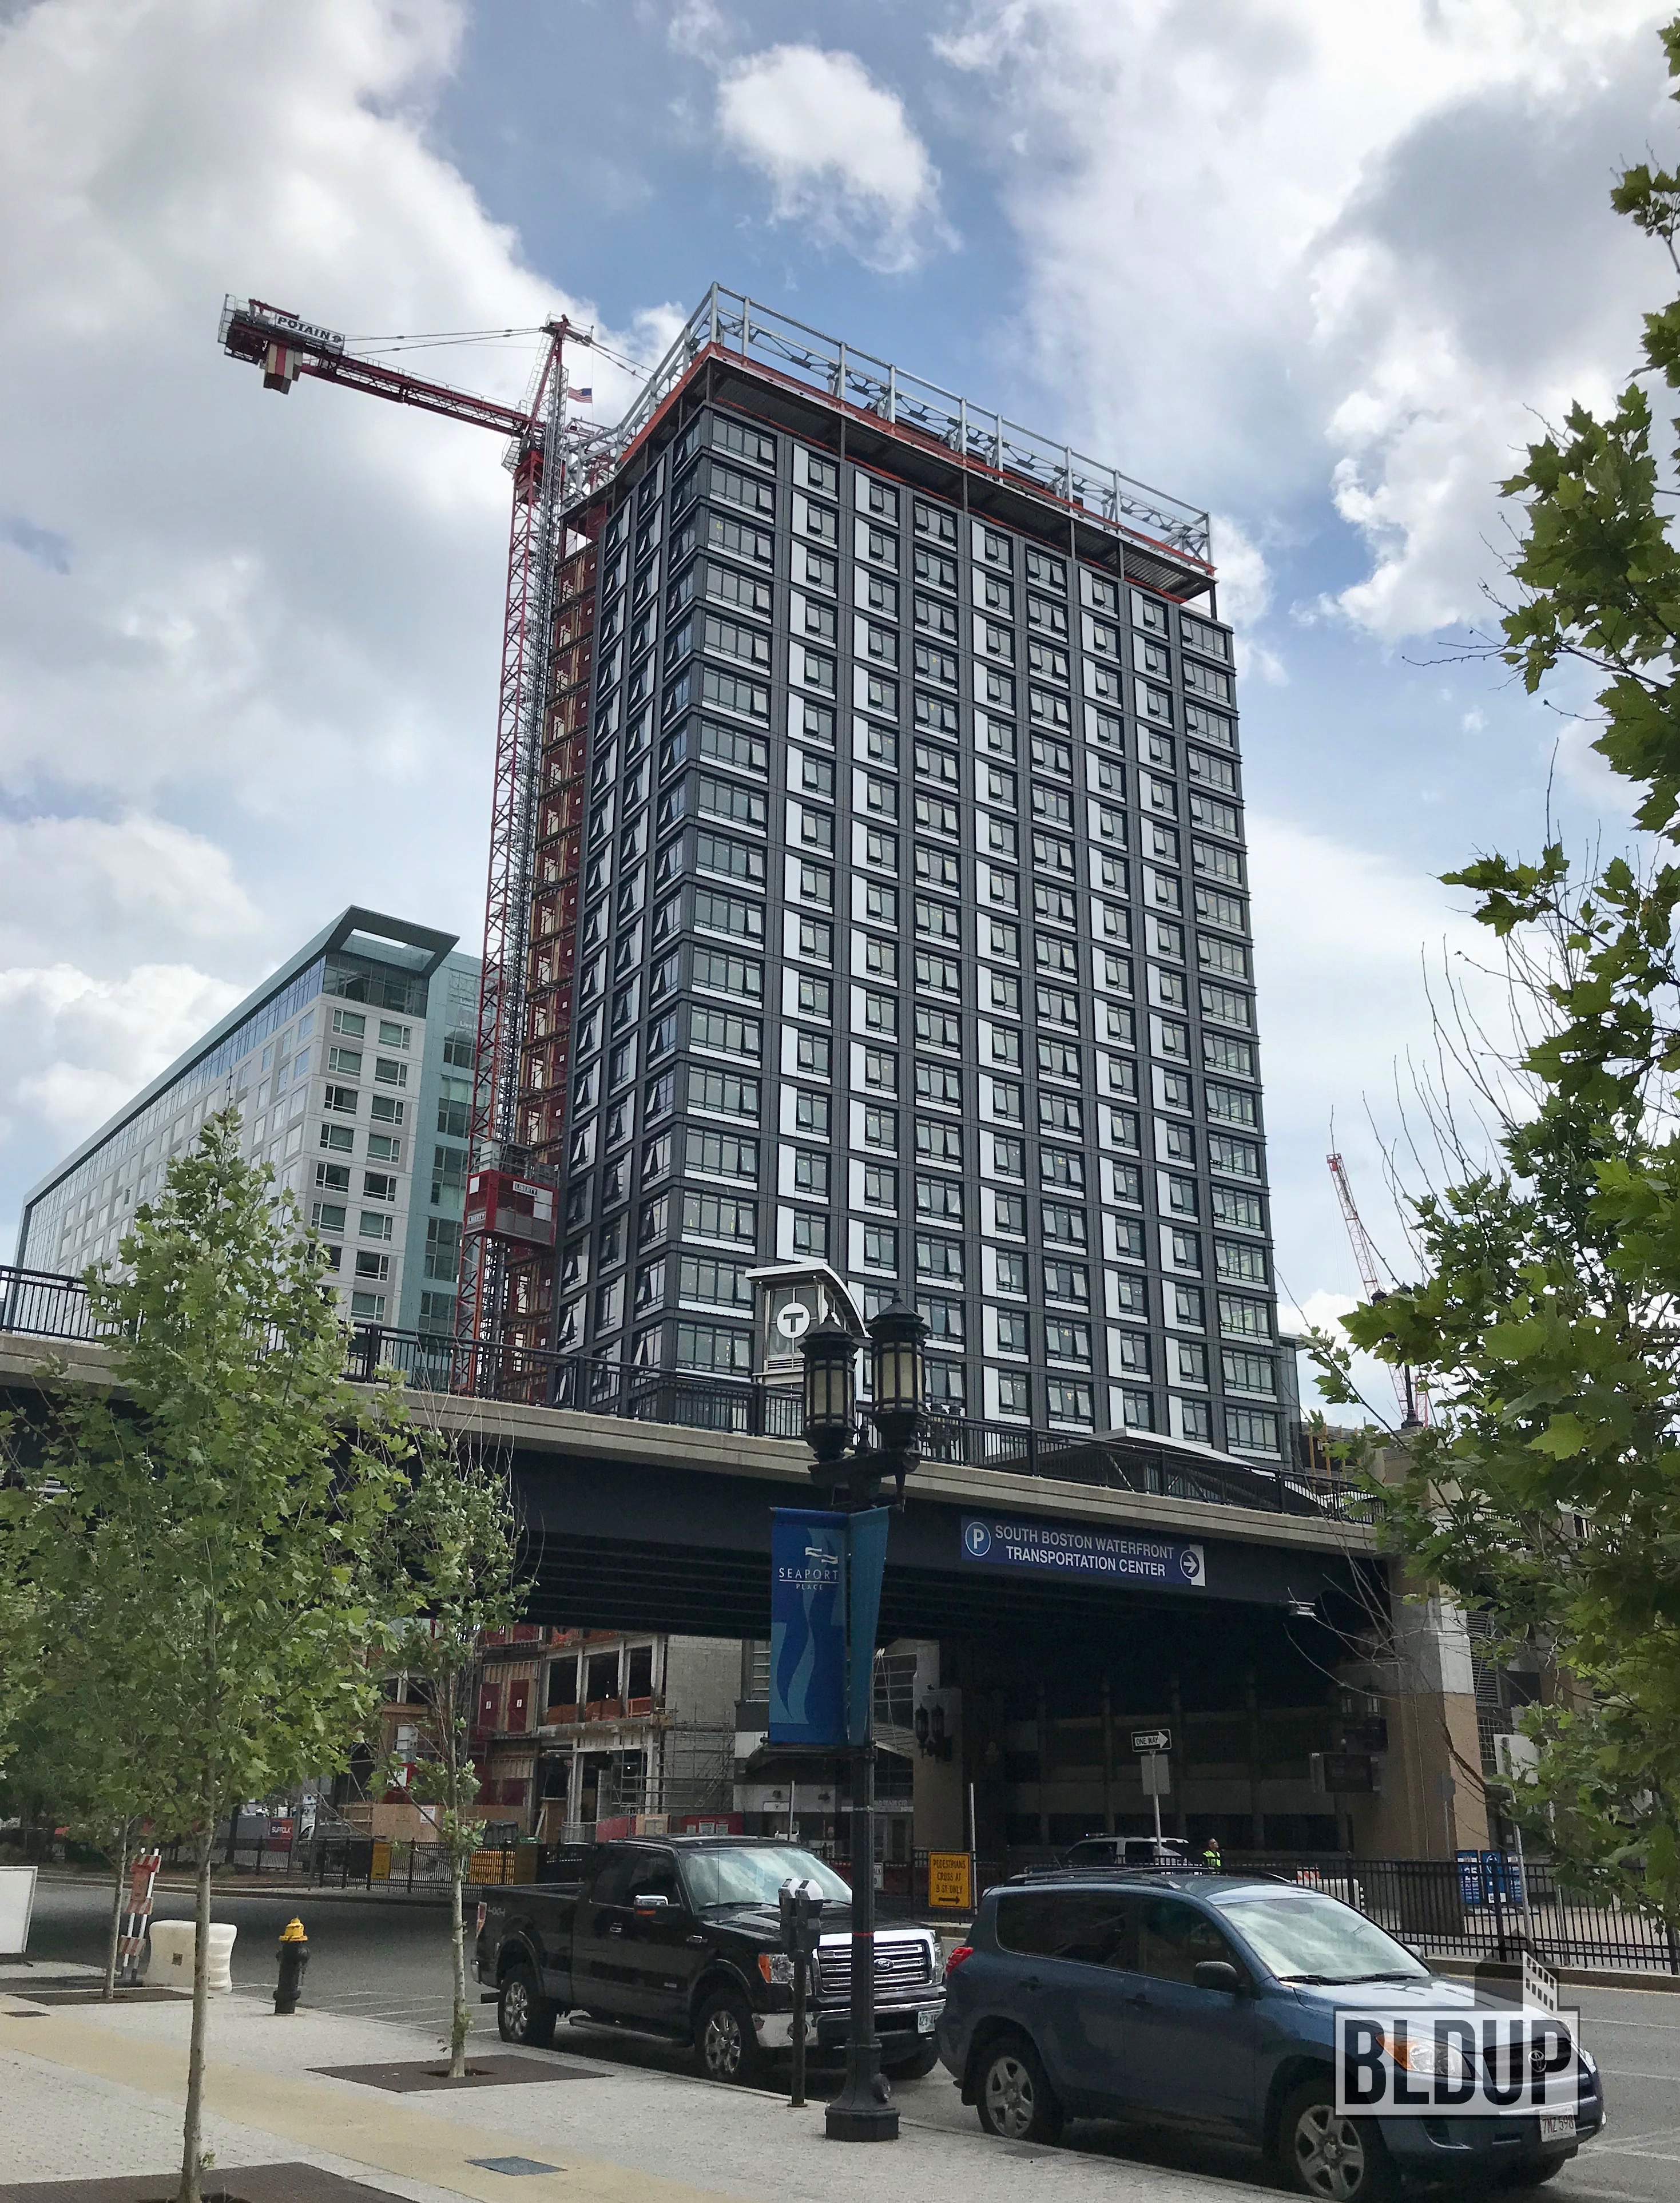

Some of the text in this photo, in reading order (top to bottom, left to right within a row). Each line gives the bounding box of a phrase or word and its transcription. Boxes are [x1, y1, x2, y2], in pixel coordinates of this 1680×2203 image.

[277, 317, 330, 340] POTAIN
[515, 1182, 538, 1195] LIBERTY
[783, 1312, 804, 1332] T
[973, 1528, 984, 1549] P
[995, 1525, 1174, 1559] SOUTH BOSTON WATERFRONT
[1006, 1545, 1166, 1577] TRANSPORTATION CENTER
[779, 1567, 839, 1580] SEAPORT
[1136, 1736, 1158, 1745] ONE WAY
[933, 1859, 966, 1869] PEDESTRIANS
[937, 1872, 962, 1882] CROSS AT
